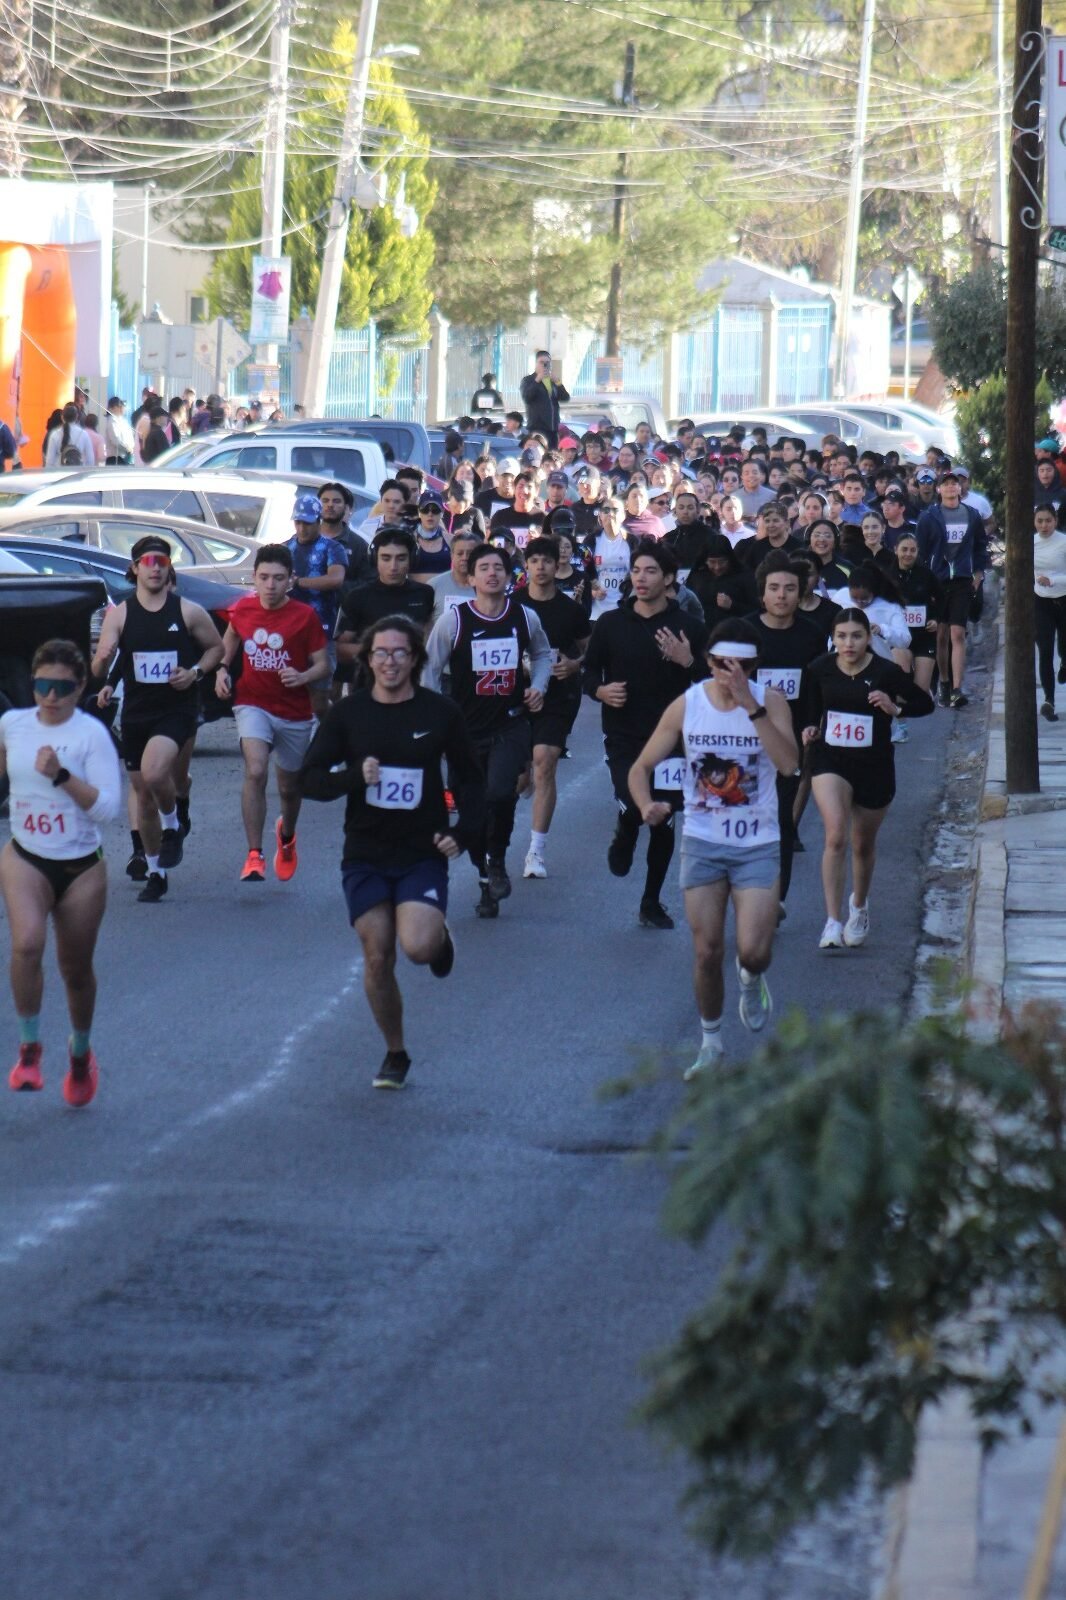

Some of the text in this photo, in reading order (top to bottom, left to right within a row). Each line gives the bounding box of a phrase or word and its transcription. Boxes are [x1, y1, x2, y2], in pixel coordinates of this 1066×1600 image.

[248, 656, 287, 669] TERRA
[255, 648, 291, 661] AQUA
[480, 649, 512, 666] 157
[140, 662, 172, 679] 144
[476, 669, 516, 696] 23
[832, 723, 865, 741] 416
[374, 780, 415, 803] 126
[23, 812, 65, 836] 461
[721, 818, 759, 839] 101
